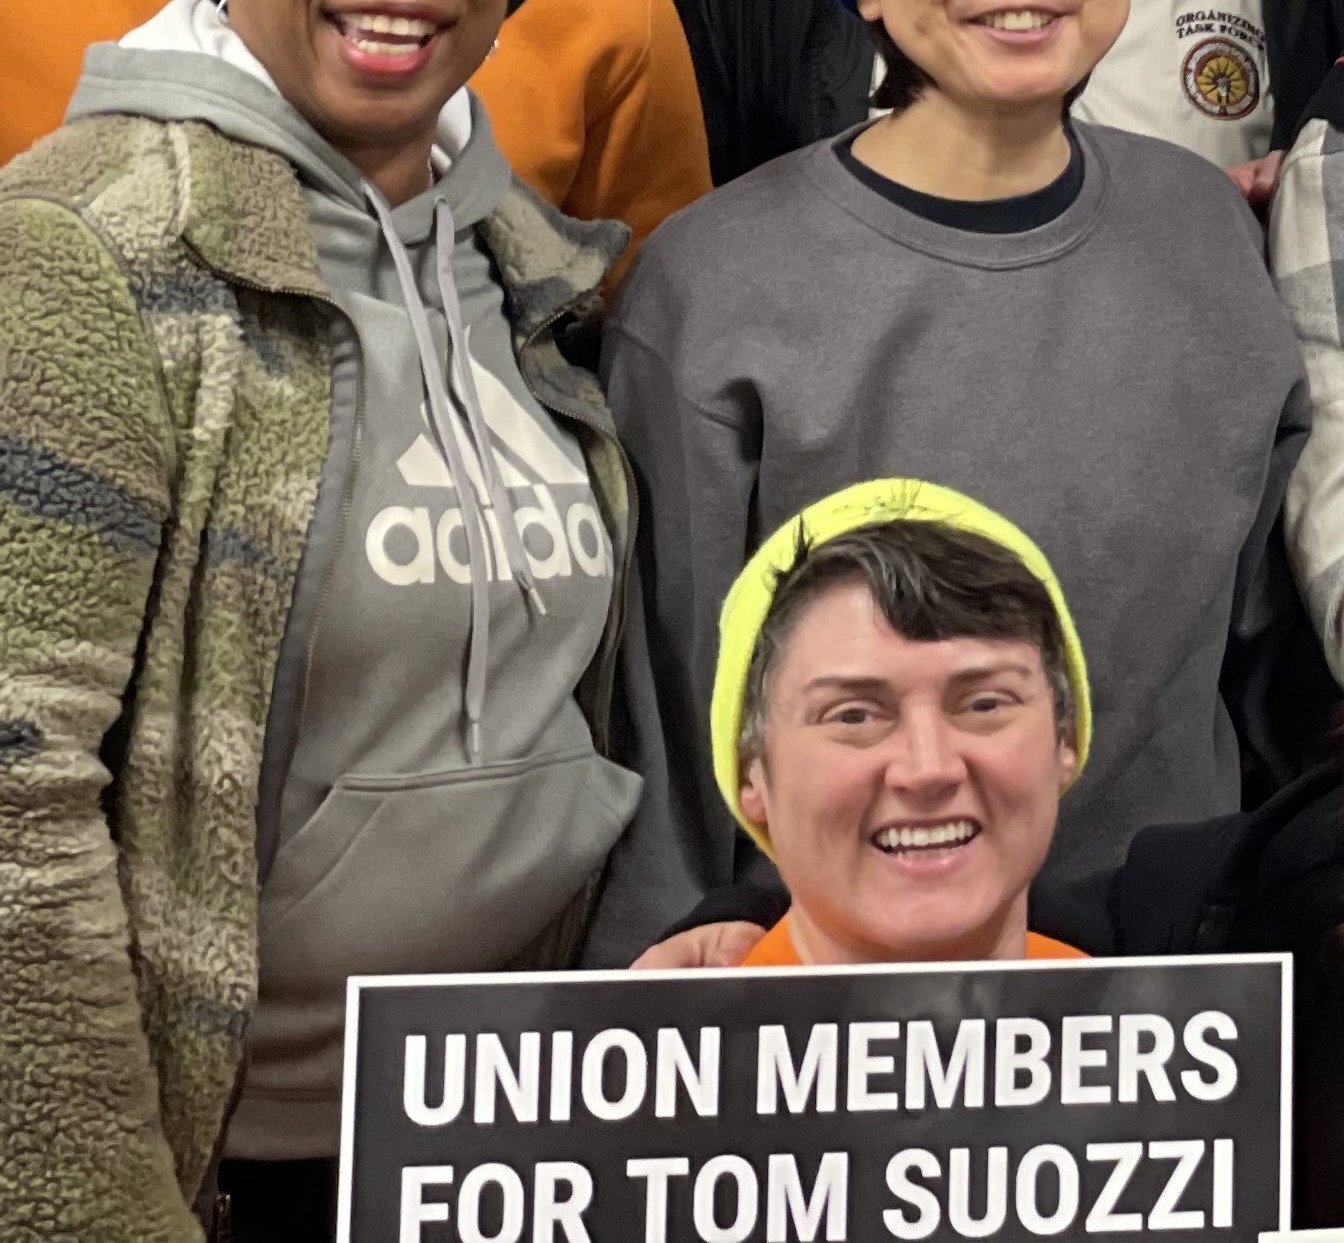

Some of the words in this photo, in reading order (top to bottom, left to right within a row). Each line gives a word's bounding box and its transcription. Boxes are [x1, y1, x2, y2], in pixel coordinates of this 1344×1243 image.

[402, 1026, 722, 1127] UNION
[755, 1009, 1239, 1115] MEMBERS
[398, 1161, 595, 1243] FOR
[625, 1151, 849, 1243] TOM
[881, 1137, 1234, 1242] SUOZZI
